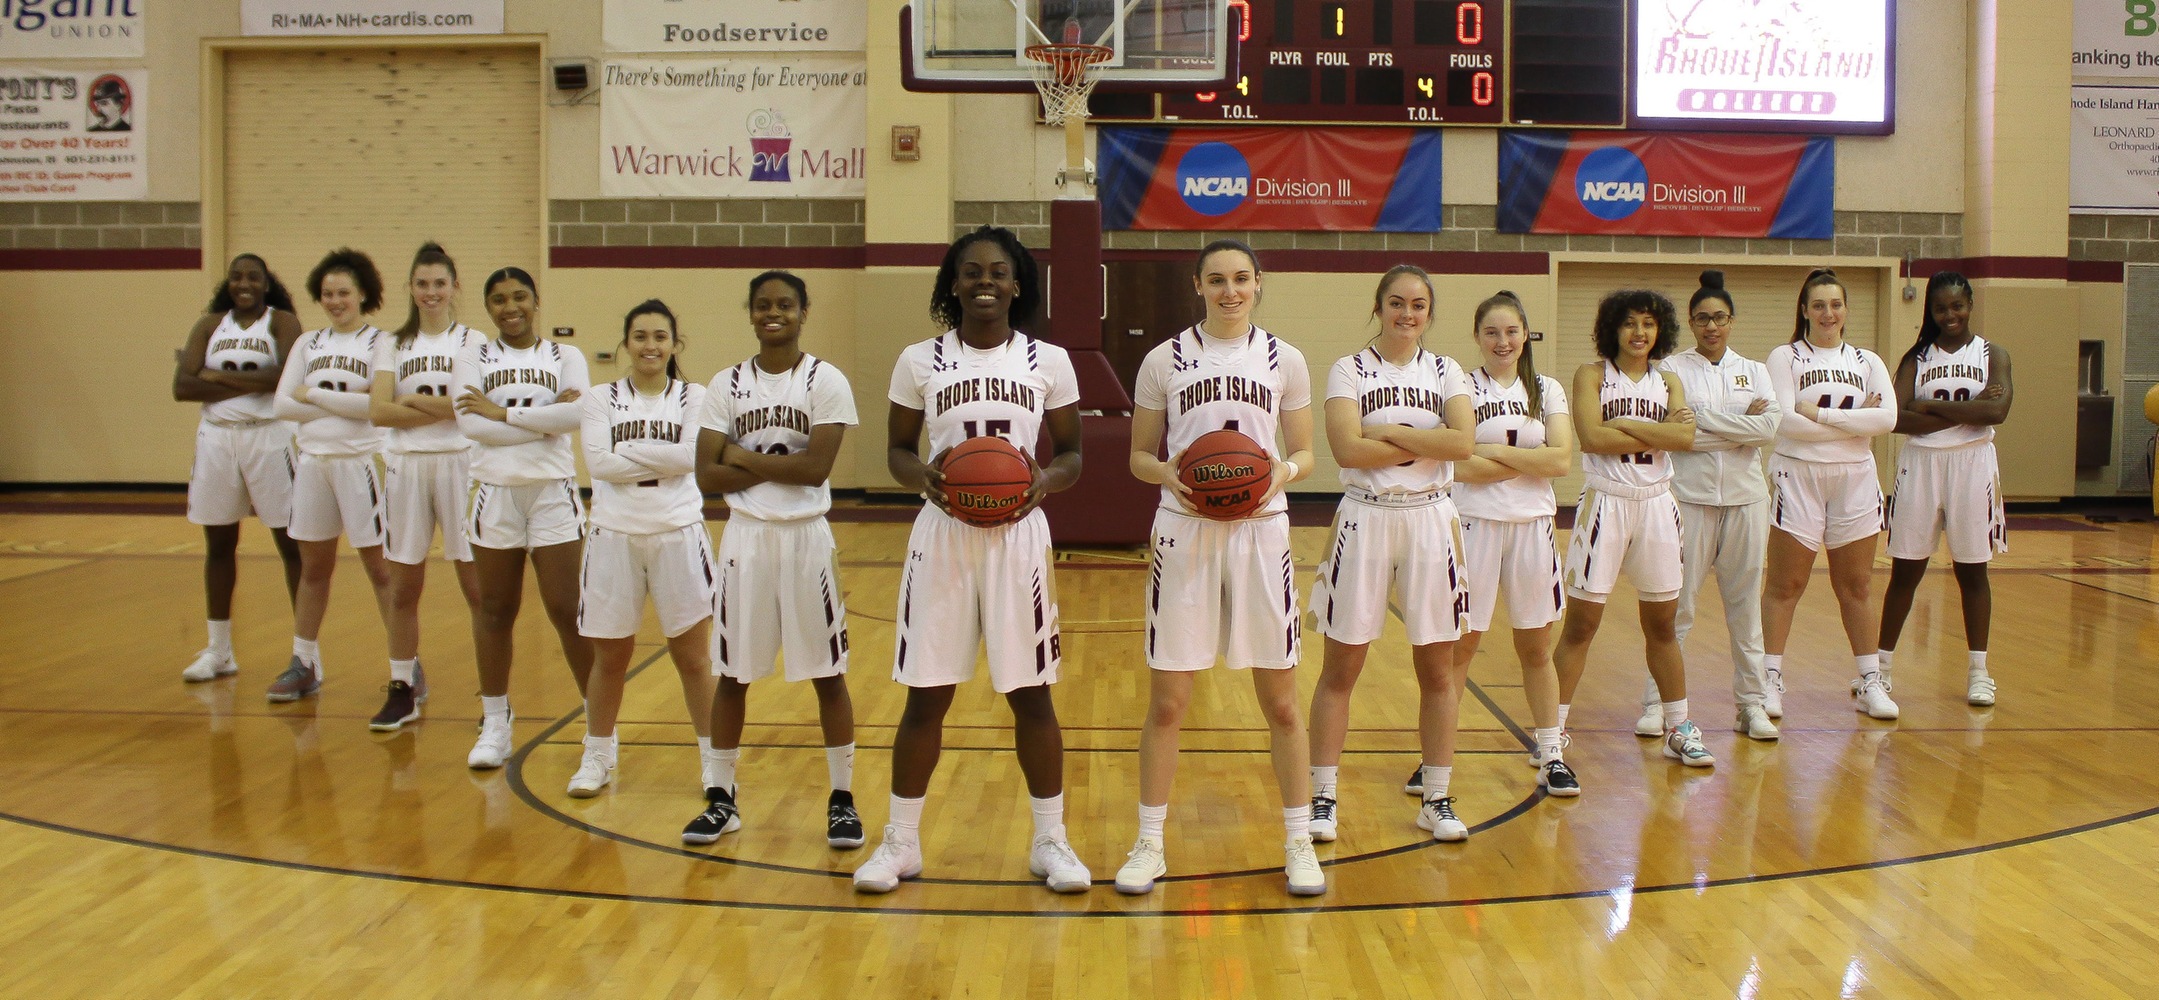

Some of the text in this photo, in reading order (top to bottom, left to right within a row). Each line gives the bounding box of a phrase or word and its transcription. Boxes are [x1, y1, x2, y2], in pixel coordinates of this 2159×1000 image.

[50, 24, 130, 38] UNION
[663, 22, 828, 42] Foodservice
[1335, 7, 1344, 36] 1
[1456, 2, 1483, 44] 0
[1269, 52, 1492, 68] PLYR FOUL PTS FOULS
[2072, 49, 2130, 69] anking
[605, 65, 659, 86] There's
[664, 67, 746, 92] Something
[751, 67, 774, 91] for
[778, 67, 848, 91] Everyone
[1417, 77, 1433, 98] 4
[1471, 72, 1494, 105] 0
[1222, 106, 1443, 121] T.O.L. T.O.L.
[2100, 98, 2134, 109] Island
[2093, 126, 2155, 138] LEONARD
[20, 138, 56, 149] Over
[60, 137, 79, 148] 40
[83, 137, 129, 149] Years!
[611, 146, 743, 177] Warwick
[799, 148, 866, 179] Mall
[1183, 177, 1248, 197] NCAA
[1256, 178, 1351, 197] Division III
[1582, 181, 1646, 202] NCAA
[1653, 184, 1746, 204] Division III
[519, 368, 558, 395] ISLAND
[1951, 364, 1984, 384] ISLAND
[936, 377, 1036, 417] RHODE ISLAND
[1179, 376, 1273, 417] RHODE ISLAND
[1361, 386, 1400, 418] RHODE
[1602, 397, 1632, 421] RHODE
[735, 406, 769, 438] RHODE
[1192, 463, 1255, 484] Wilson
[957, 491, 1018, 509] Wilson
[1205, 490, 1251, 507] NCAA
